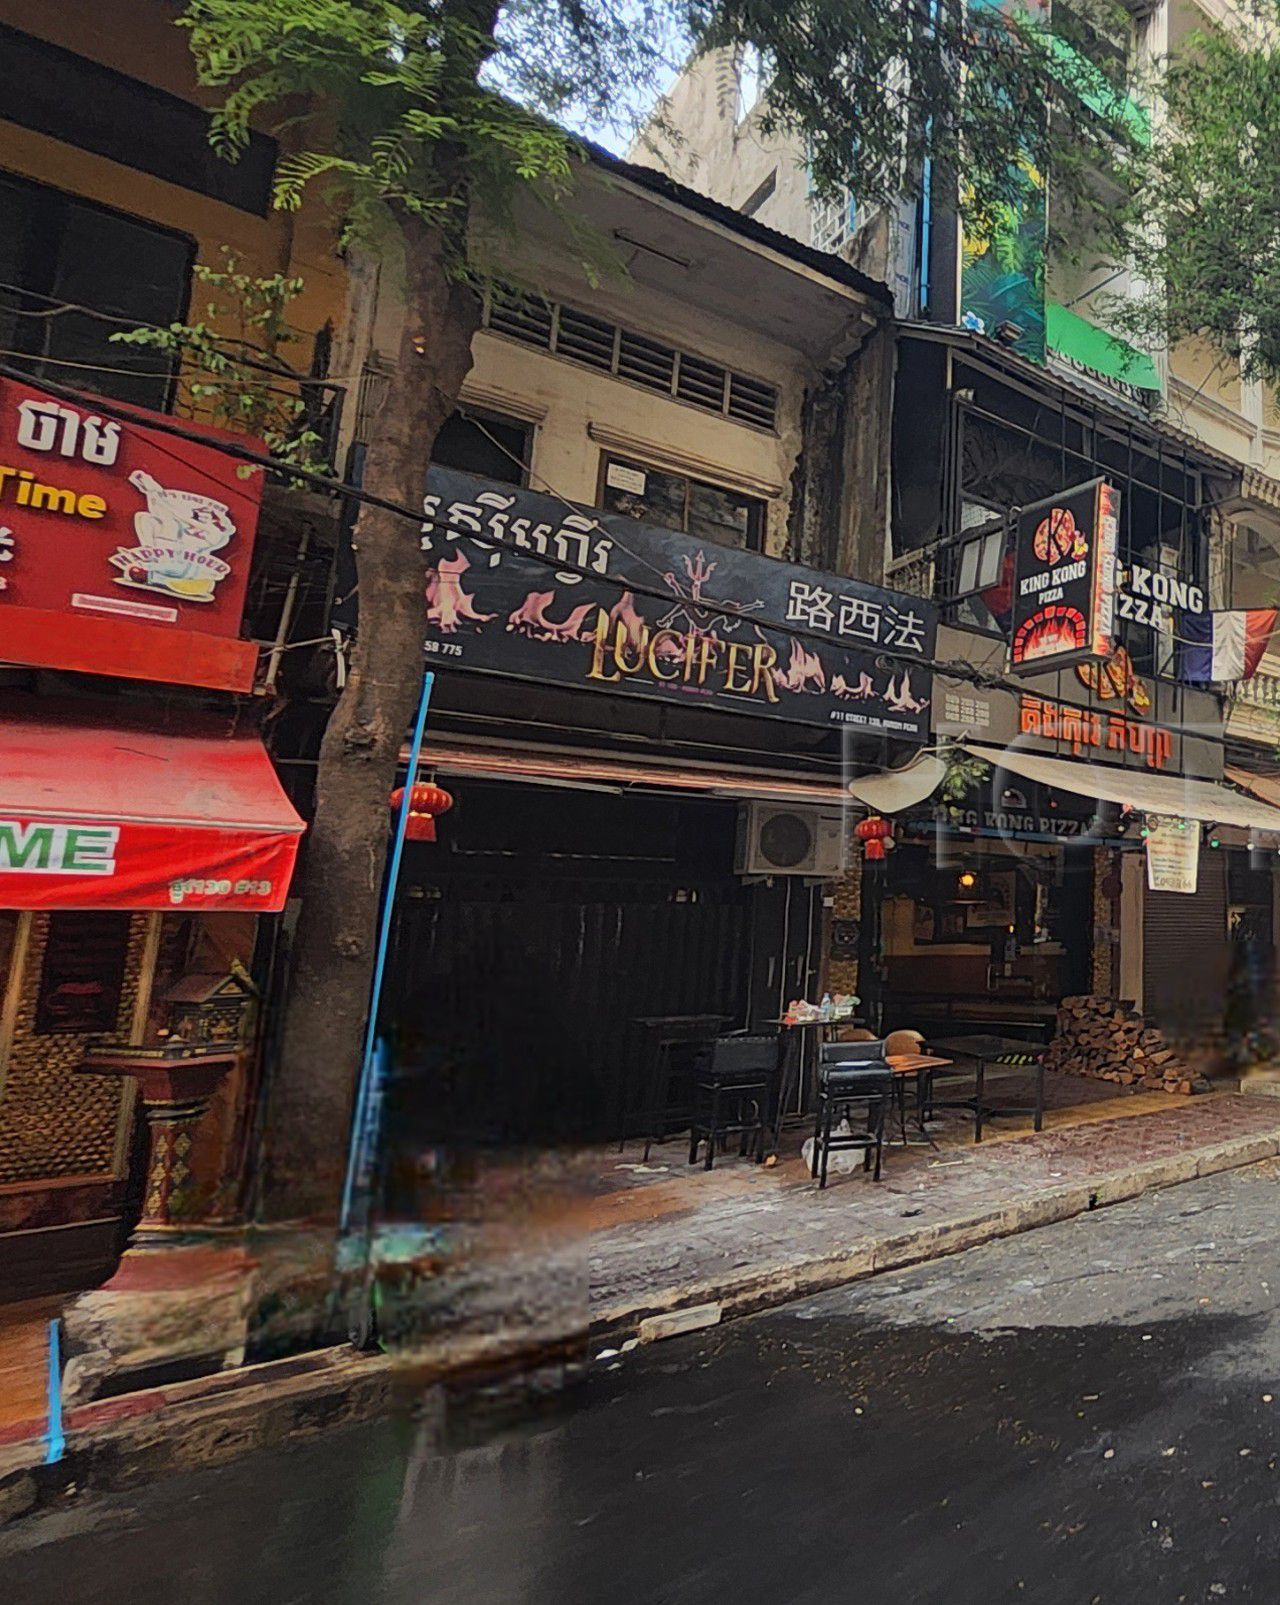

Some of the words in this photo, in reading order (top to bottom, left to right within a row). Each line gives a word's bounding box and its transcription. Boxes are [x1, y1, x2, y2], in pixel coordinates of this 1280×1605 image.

[182, 549, 228, 574] HOUR
[1020, 571, 1050, 596] KING
[1051, 560, 1087, 583] KONG
[1038, 587, 1065, 605] PIZZA
[1131, 564, 1204, 615] KONG
[786, 581, 926, 653] 路西法
[585, 608, 780, 703] LUCIFER
[984, 810, 1034, 832] KONG
